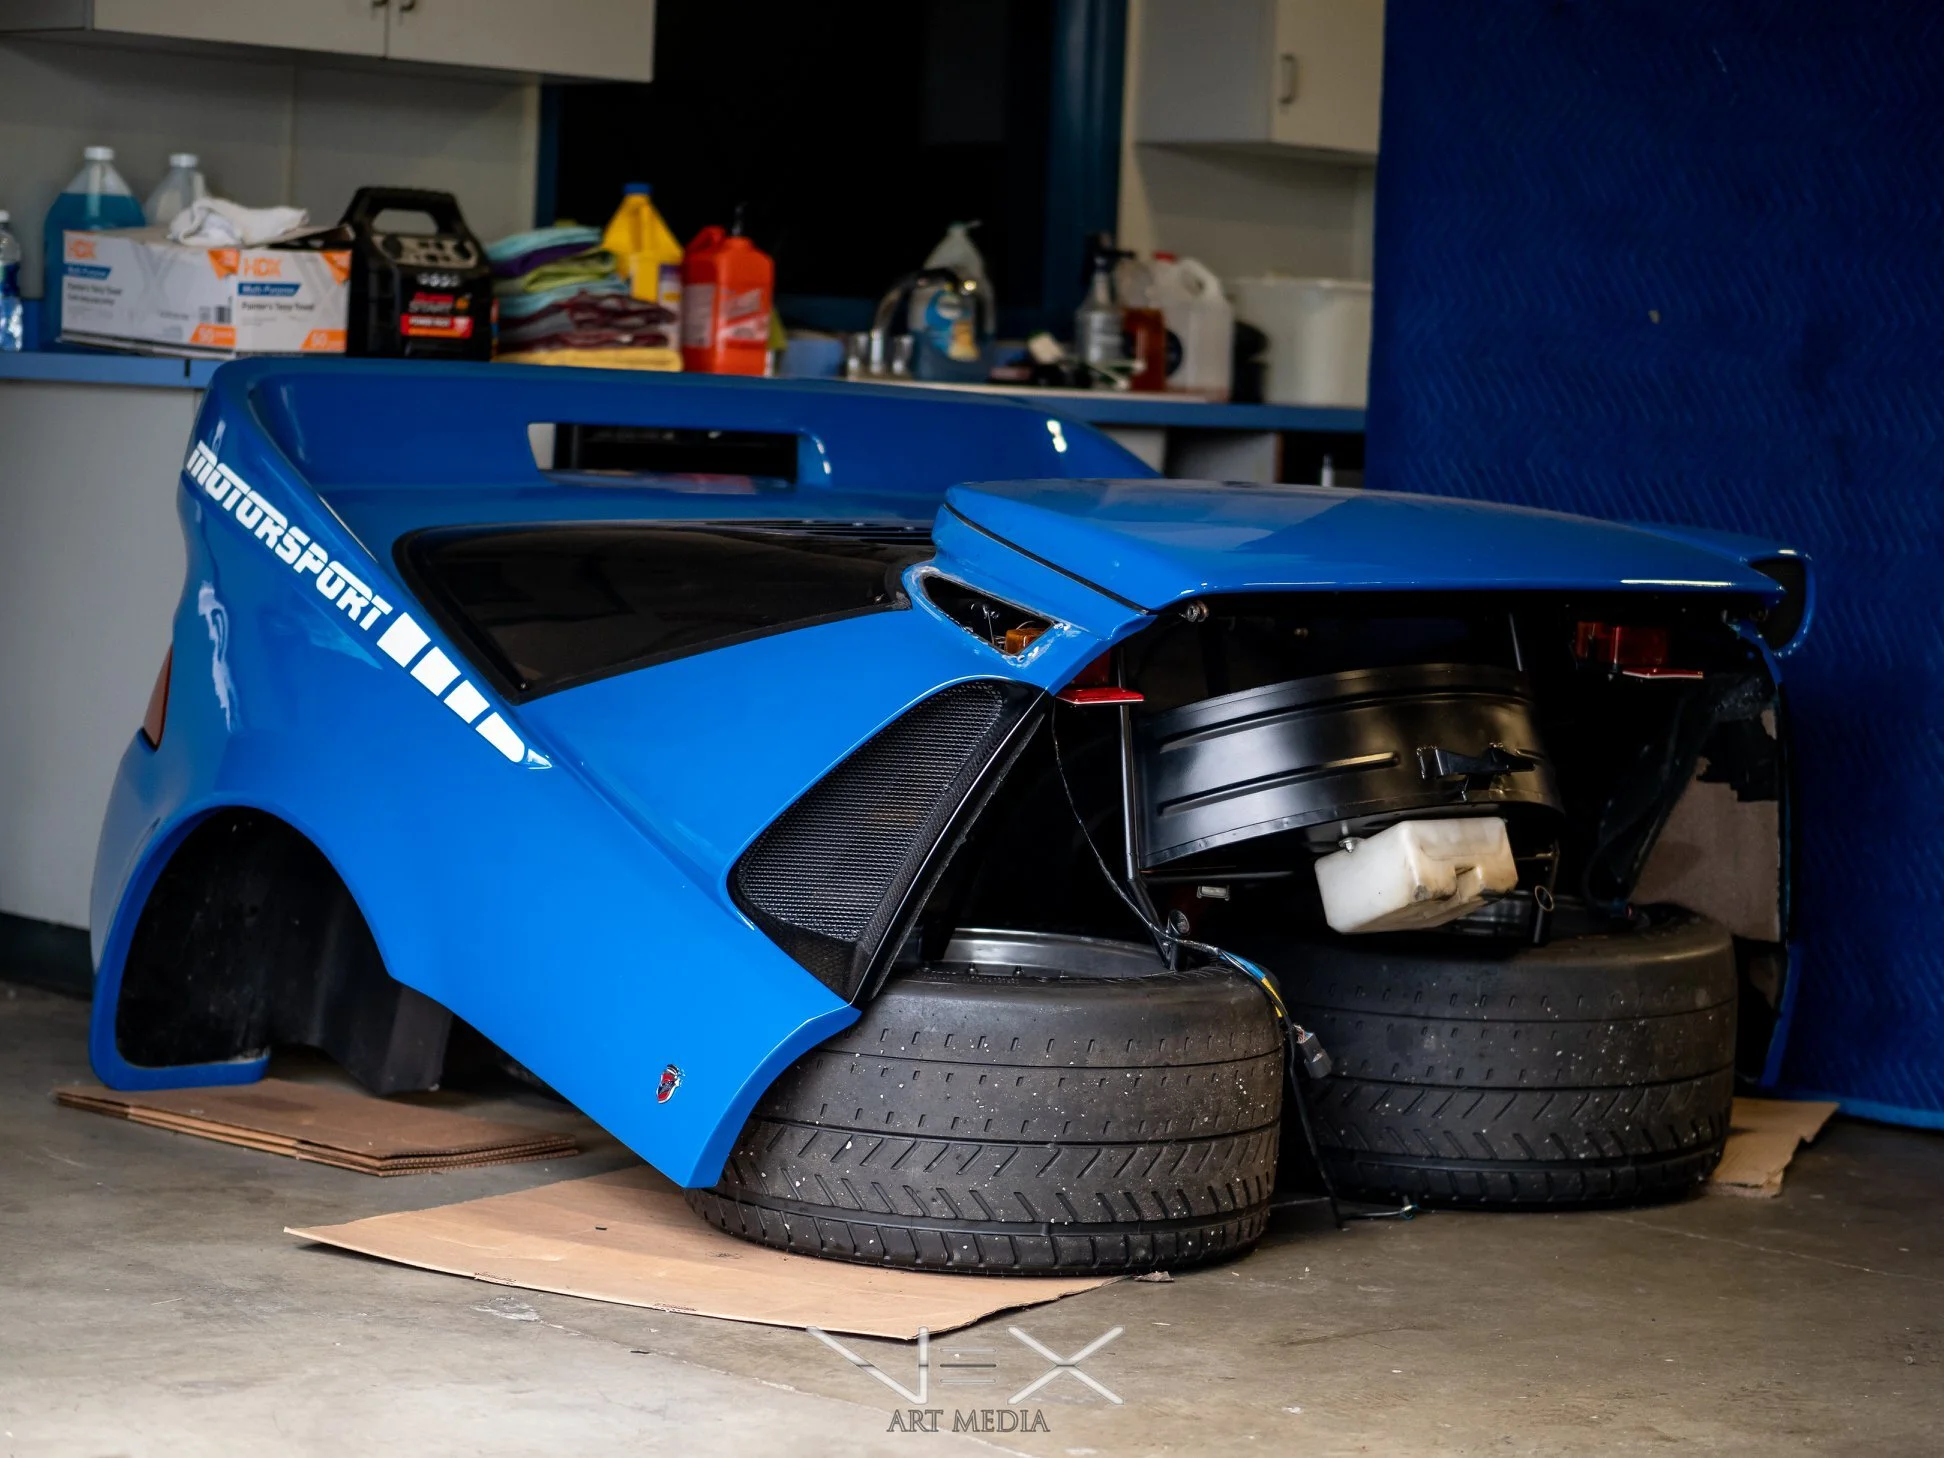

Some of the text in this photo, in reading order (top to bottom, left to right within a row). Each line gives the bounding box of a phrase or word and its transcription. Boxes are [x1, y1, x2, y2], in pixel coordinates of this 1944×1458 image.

[67, 239, 96, 259] HDX
[243, 257, 283, 278] HDX
[186, 440, 393, 631] MOTORSPORT
